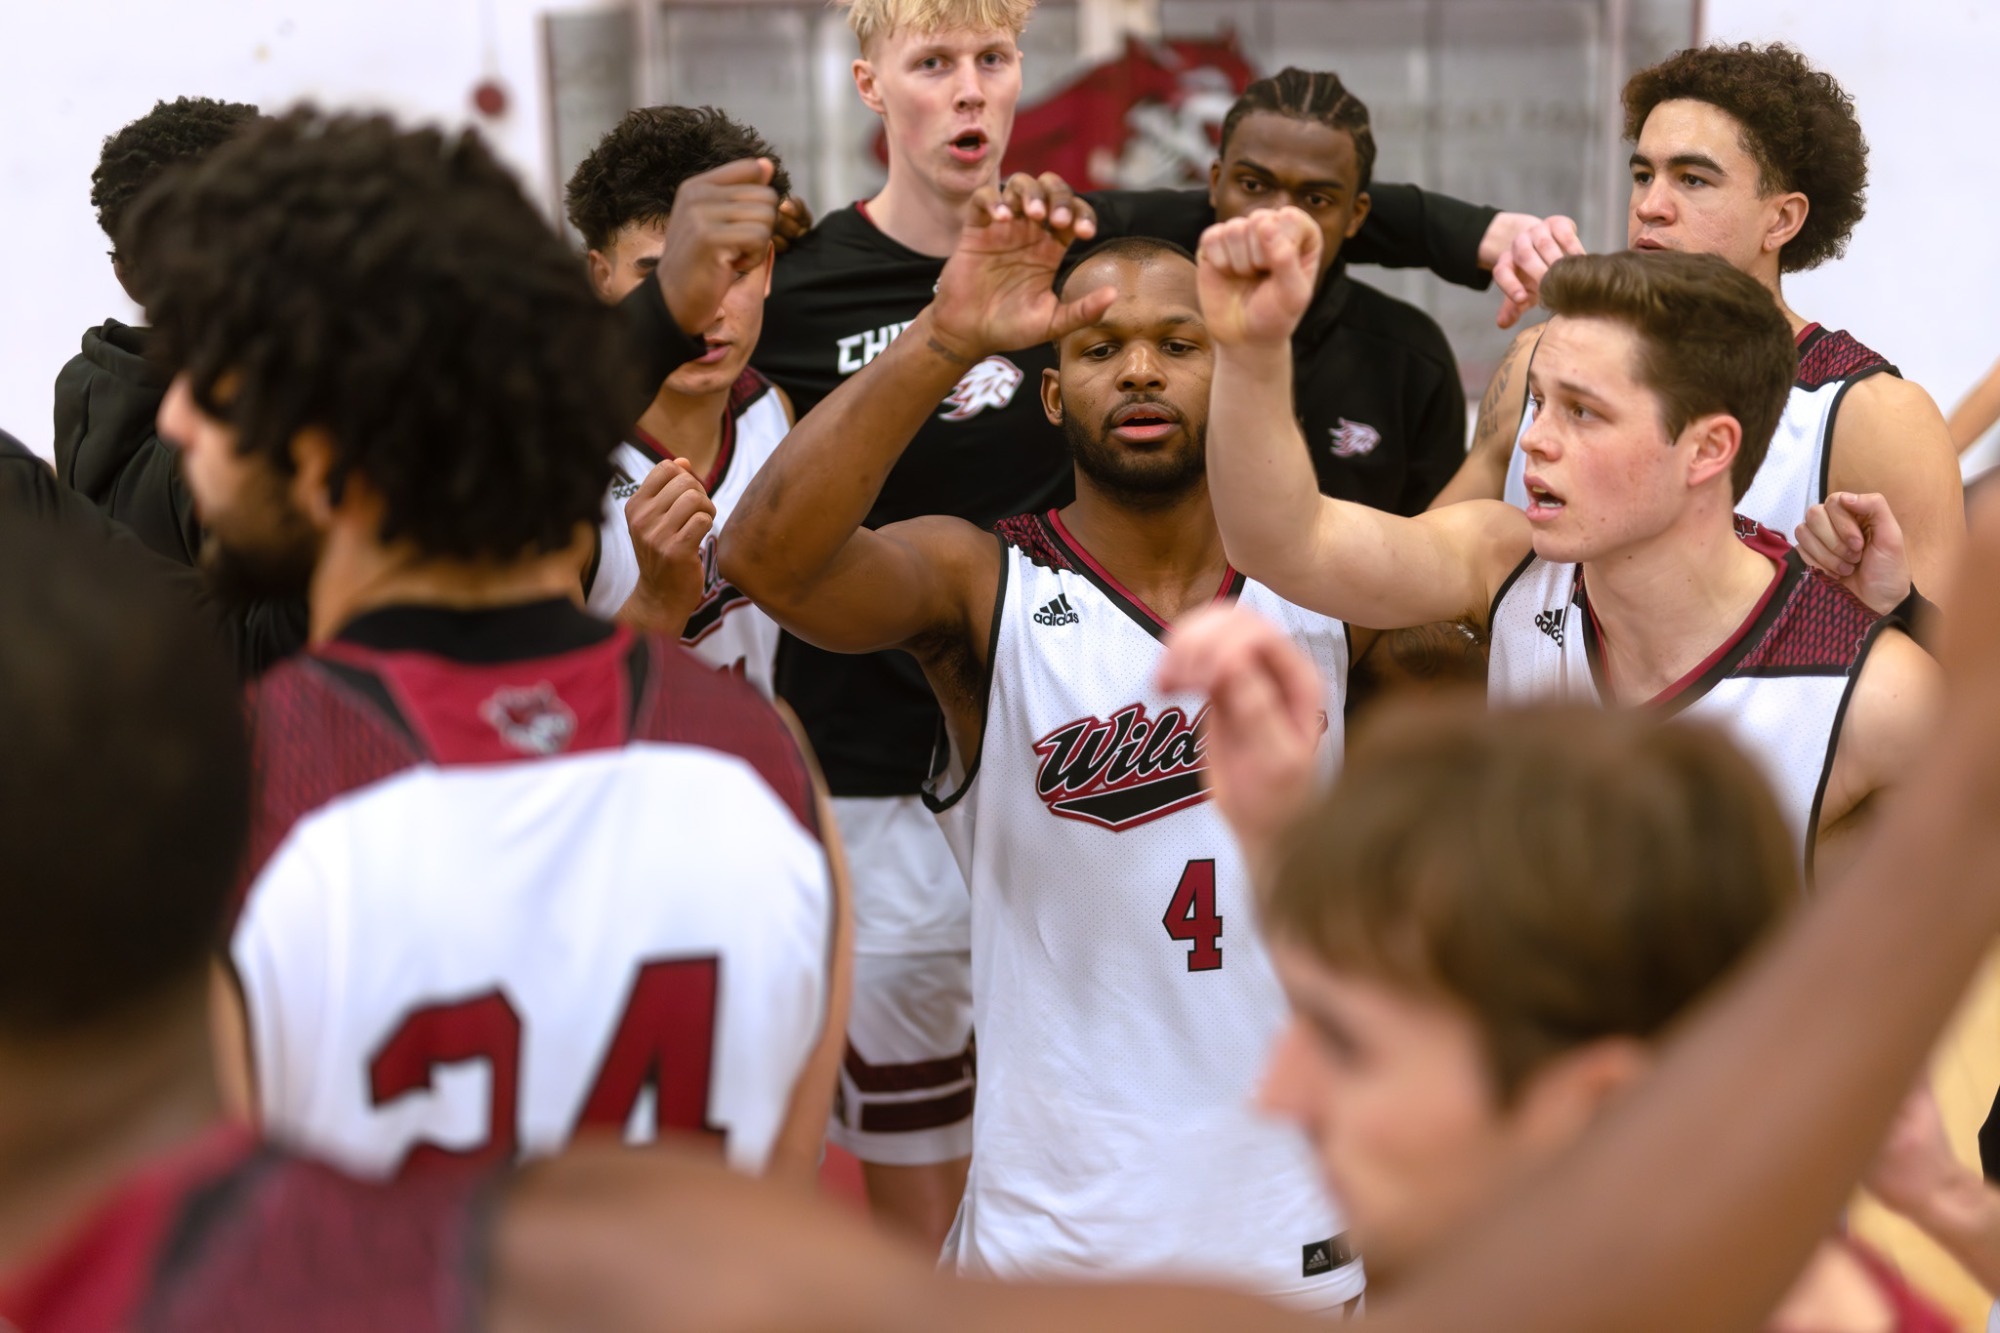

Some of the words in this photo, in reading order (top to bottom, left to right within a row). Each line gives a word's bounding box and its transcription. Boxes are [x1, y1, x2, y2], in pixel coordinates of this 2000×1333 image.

[1033, 611, 1080, 626] adidas
[1534, 613, 1564, 648] adida
[1033, 702, 1214, 804] Wild
[1162, 858, 1223, 972] 4
[367, 953, 730, 1176] 24
